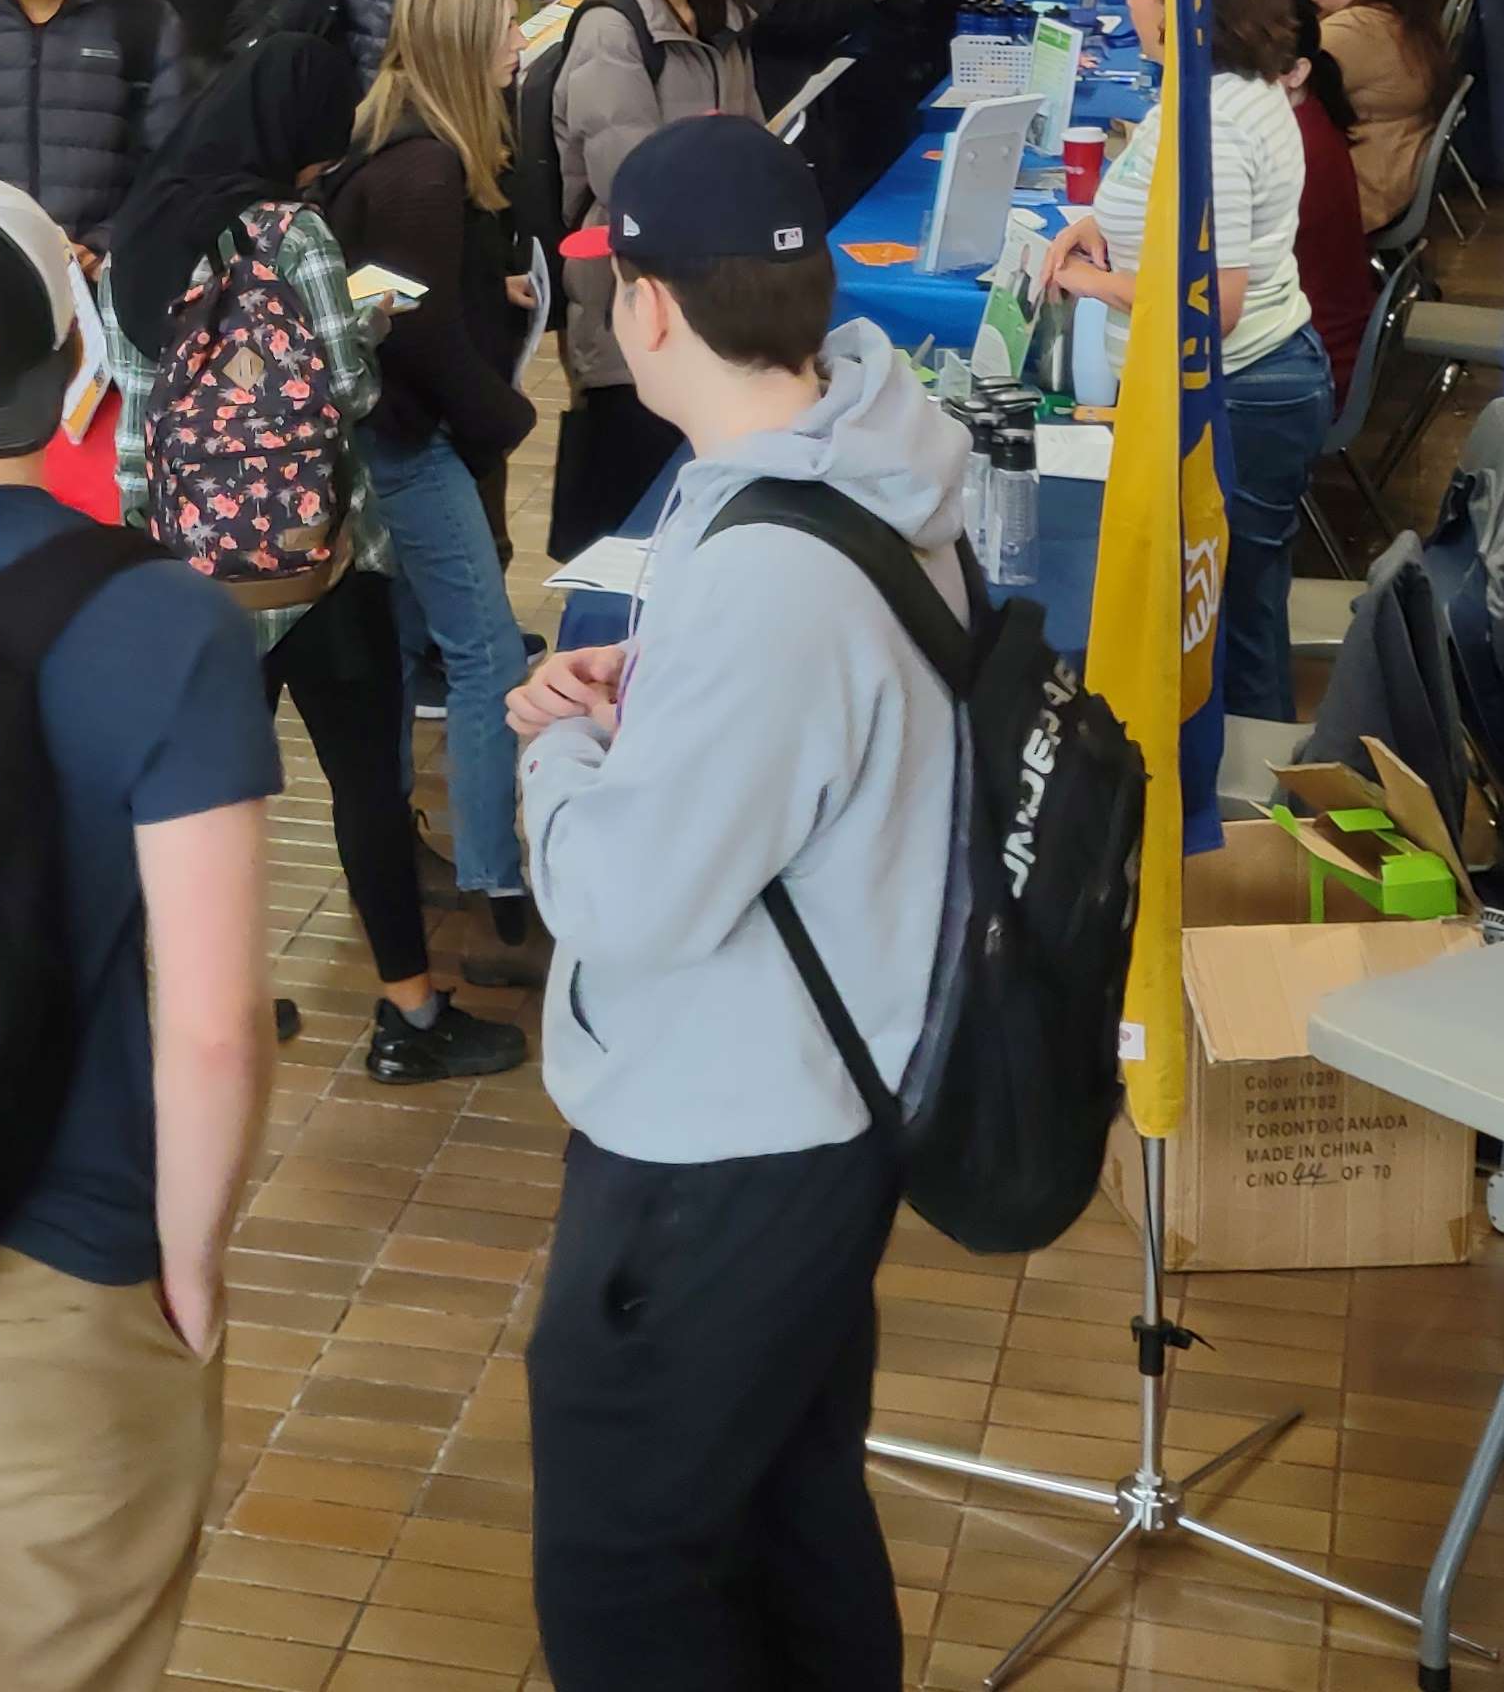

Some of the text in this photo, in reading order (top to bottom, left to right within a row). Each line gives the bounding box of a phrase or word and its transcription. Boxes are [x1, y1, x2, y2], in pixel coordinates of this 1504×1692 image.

[1245, 1140, 1374, 1165] MADE IN CHINA
[1341, 1165, 1366, 1181] OF
